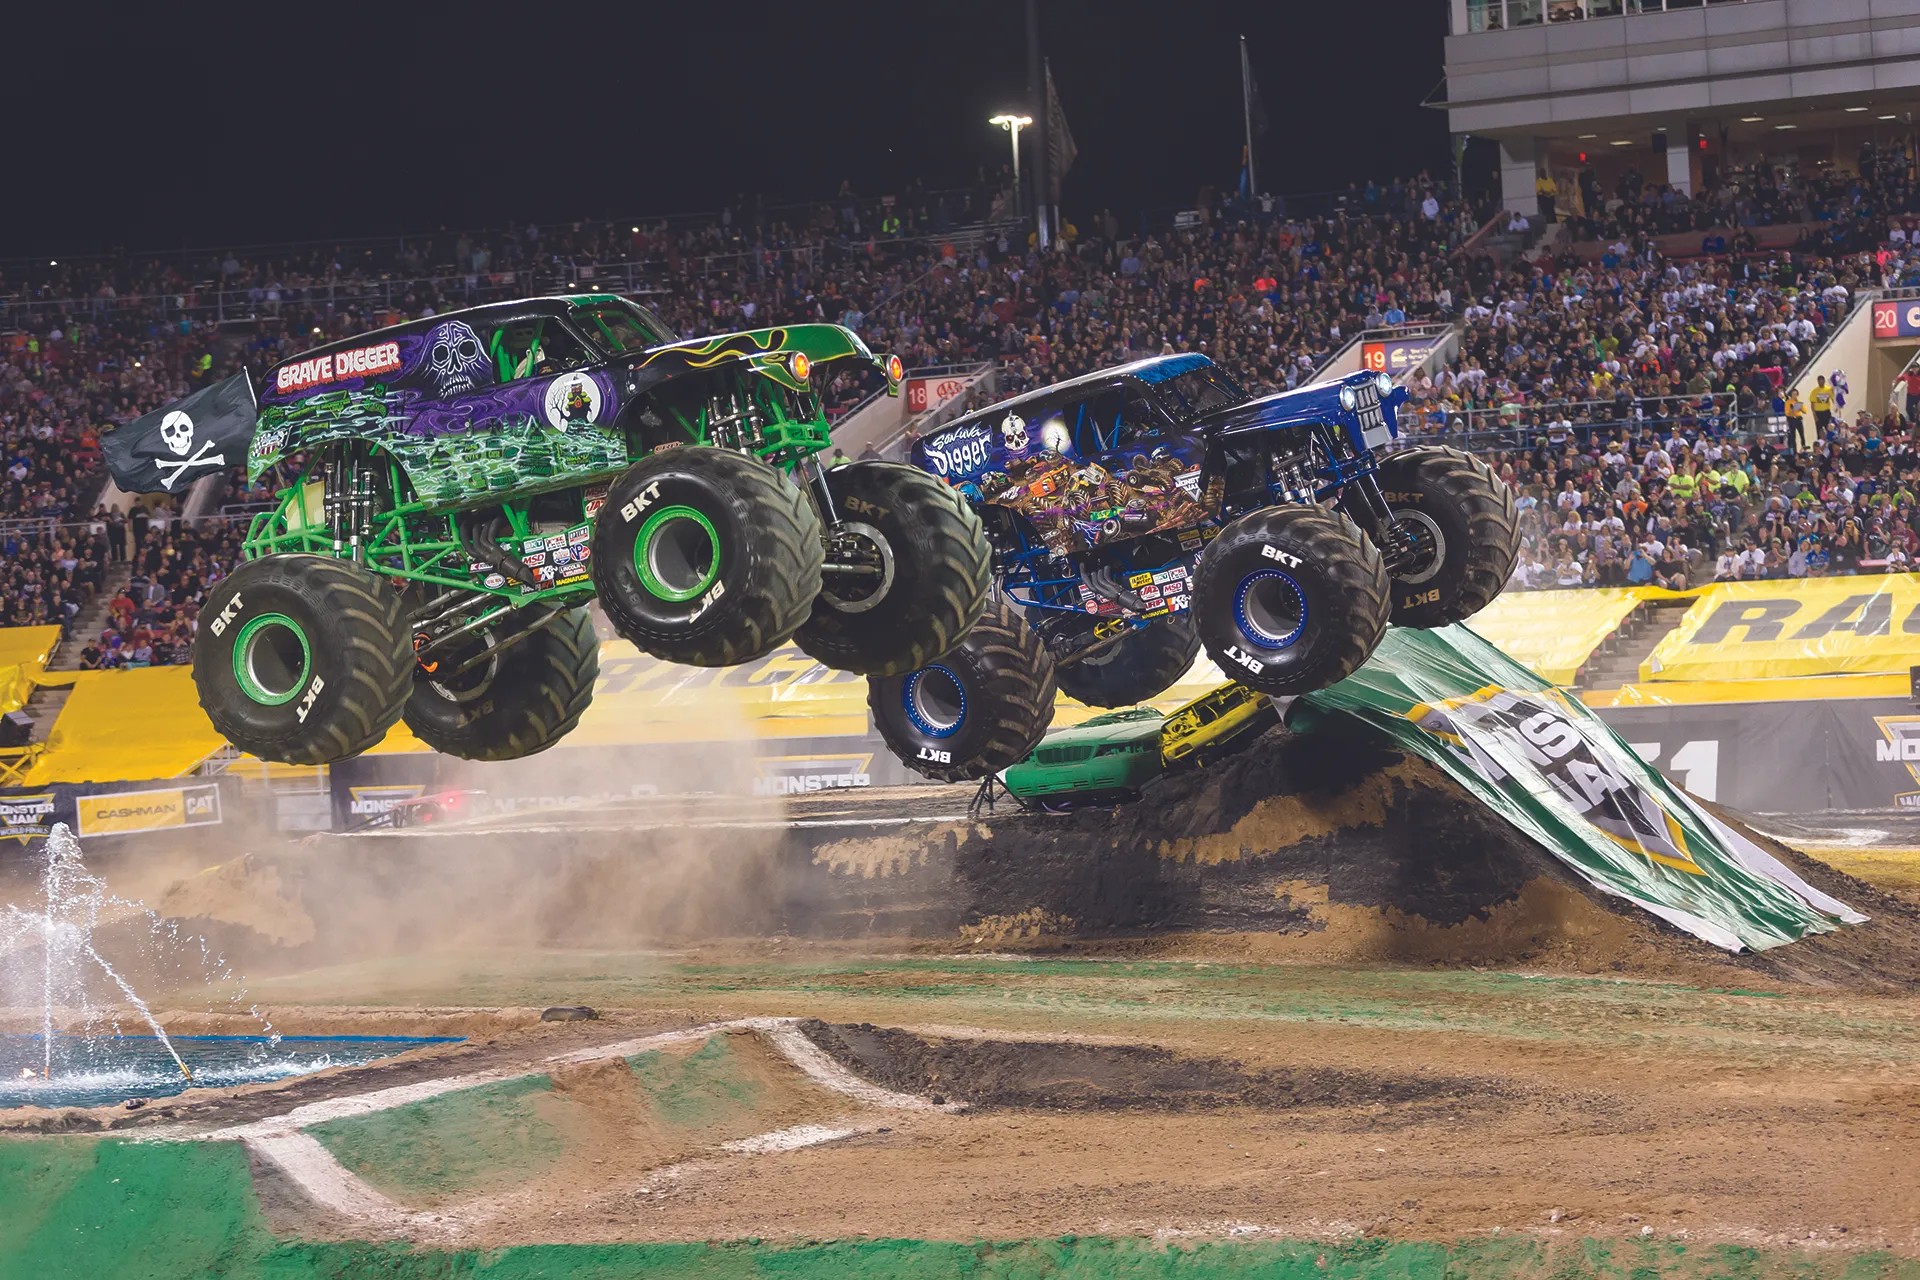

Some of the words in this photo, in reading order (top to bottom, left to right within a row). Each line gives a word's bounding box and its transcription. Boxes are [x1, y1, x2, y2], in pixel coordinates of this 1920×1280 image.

[1875, 309, 1897, 329] 20
[277, 355, 334, 391] GRAVE
[335, 342, 401, 379] DIGGER
[1364, 351, 1386, 369] 19
[908, 387, 926, 405] 18
[620, 481, 661, 523] BKT
[1384, 491, 1424, 504] BKT
[844, 495, 891, 521] BKT
[522, 553, 545, 566] MSD
[1261, 544, 1303, 569] BKT
[1164, 582, 1182, 593] MSD
[689, 580, 726, 624] BKT
[1403, 588, 1441, 609] BKT
[210, 592, 244, 638] BKT
[1223, 645, 1265, 675] BKT
[296, 675, 326, 725] BKT
[917, 747, 952, 764] BKT
[0, 803, 55, 815] ONSTER
[96, 804, 176, 820] CASHMAN
[186, 795, 214, 815] CAT
[8, 814, 38, 824] JAM
